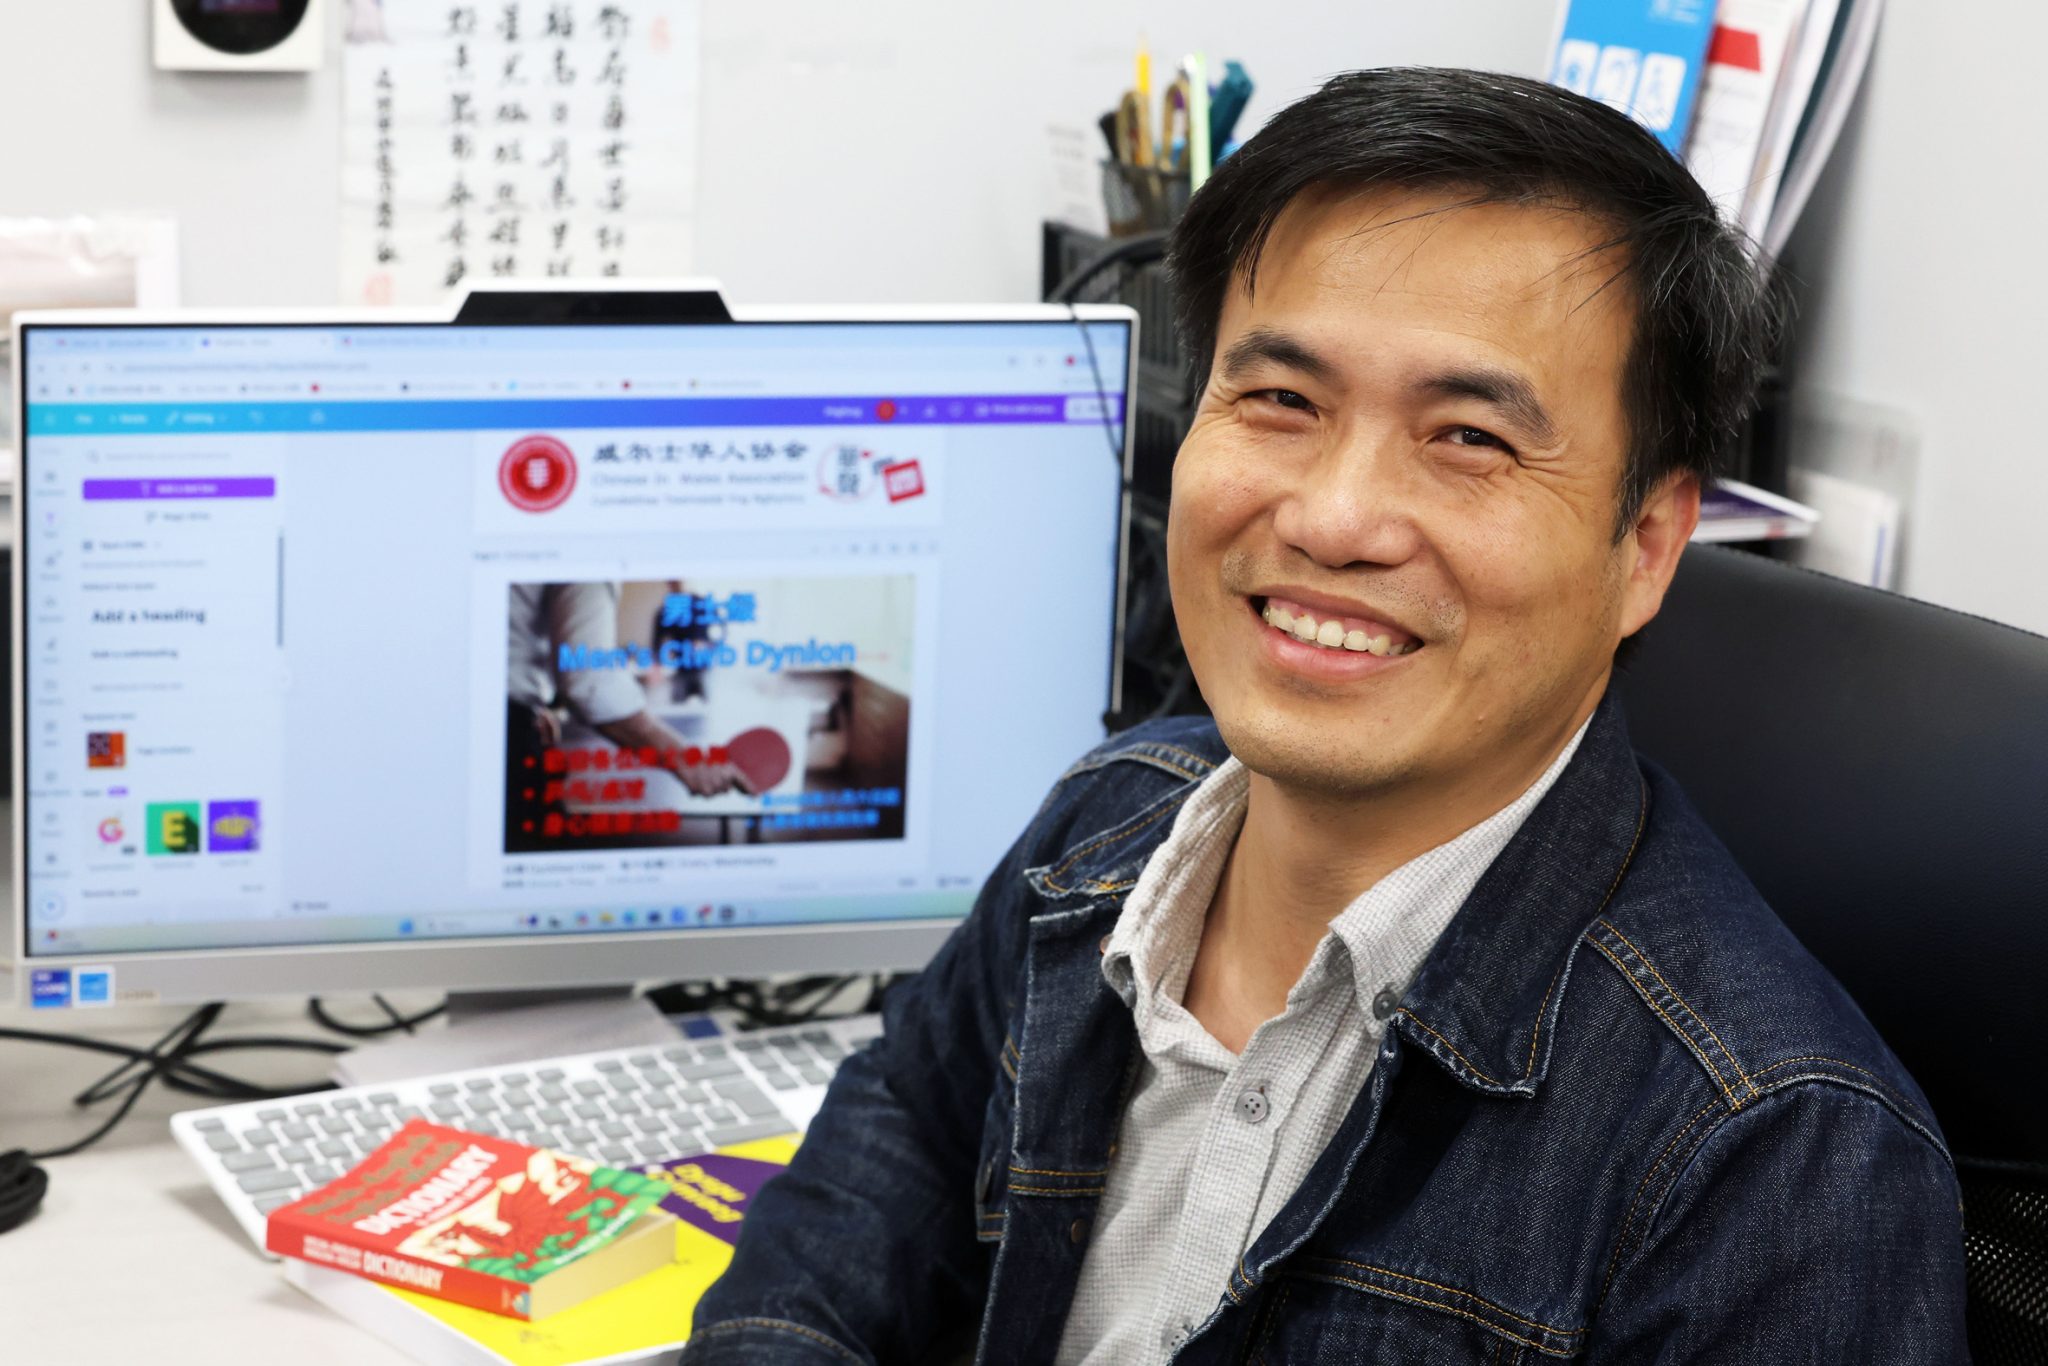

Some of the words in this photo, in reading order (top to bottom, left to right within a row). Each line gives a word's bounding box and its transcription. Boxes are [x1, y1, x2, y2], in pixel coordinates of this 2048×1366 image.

[142, 609, 206, 625] heading
[558, 642, 652, 672] Men's
[660, 639, 737, 670] Clwb
[352, 1143, 498, 1236] DICTIONARY
[362, 1249, 444, 1292] DICTIONARY
